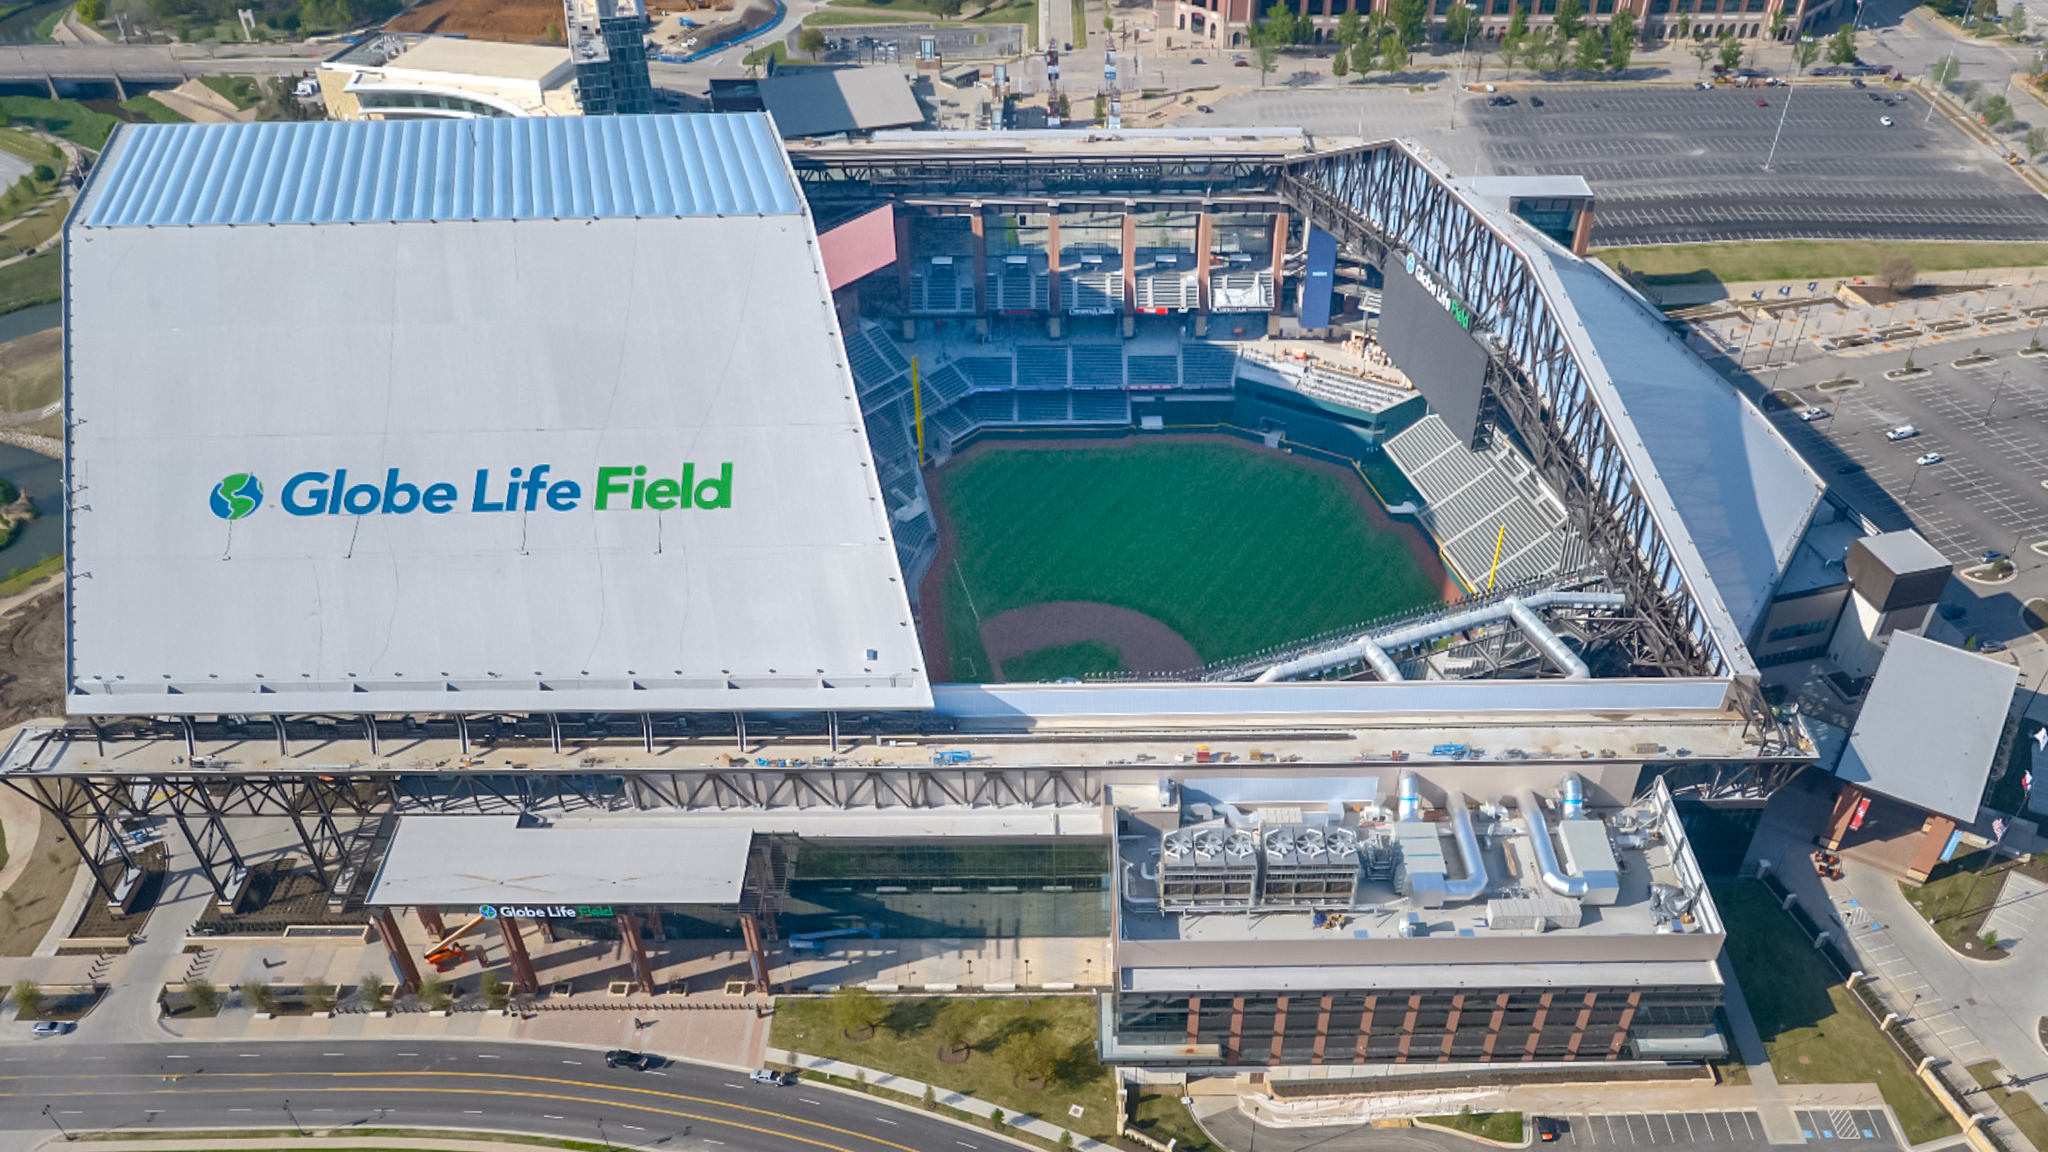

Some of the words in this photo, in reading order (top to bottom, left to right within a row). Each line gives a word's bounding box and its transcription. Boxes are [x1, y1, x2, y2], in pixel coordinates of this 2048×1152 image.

[1415, 264, 1436, 296] Globe
[281, 468, 457, 516] Globe
[472, 464, 581, 512] Life
[595, 462, 733, 510] Field
[500, 906, 546, 917] Globe
[547, 906, 576, 917] Life
[577, 905, 614, 917] Field
